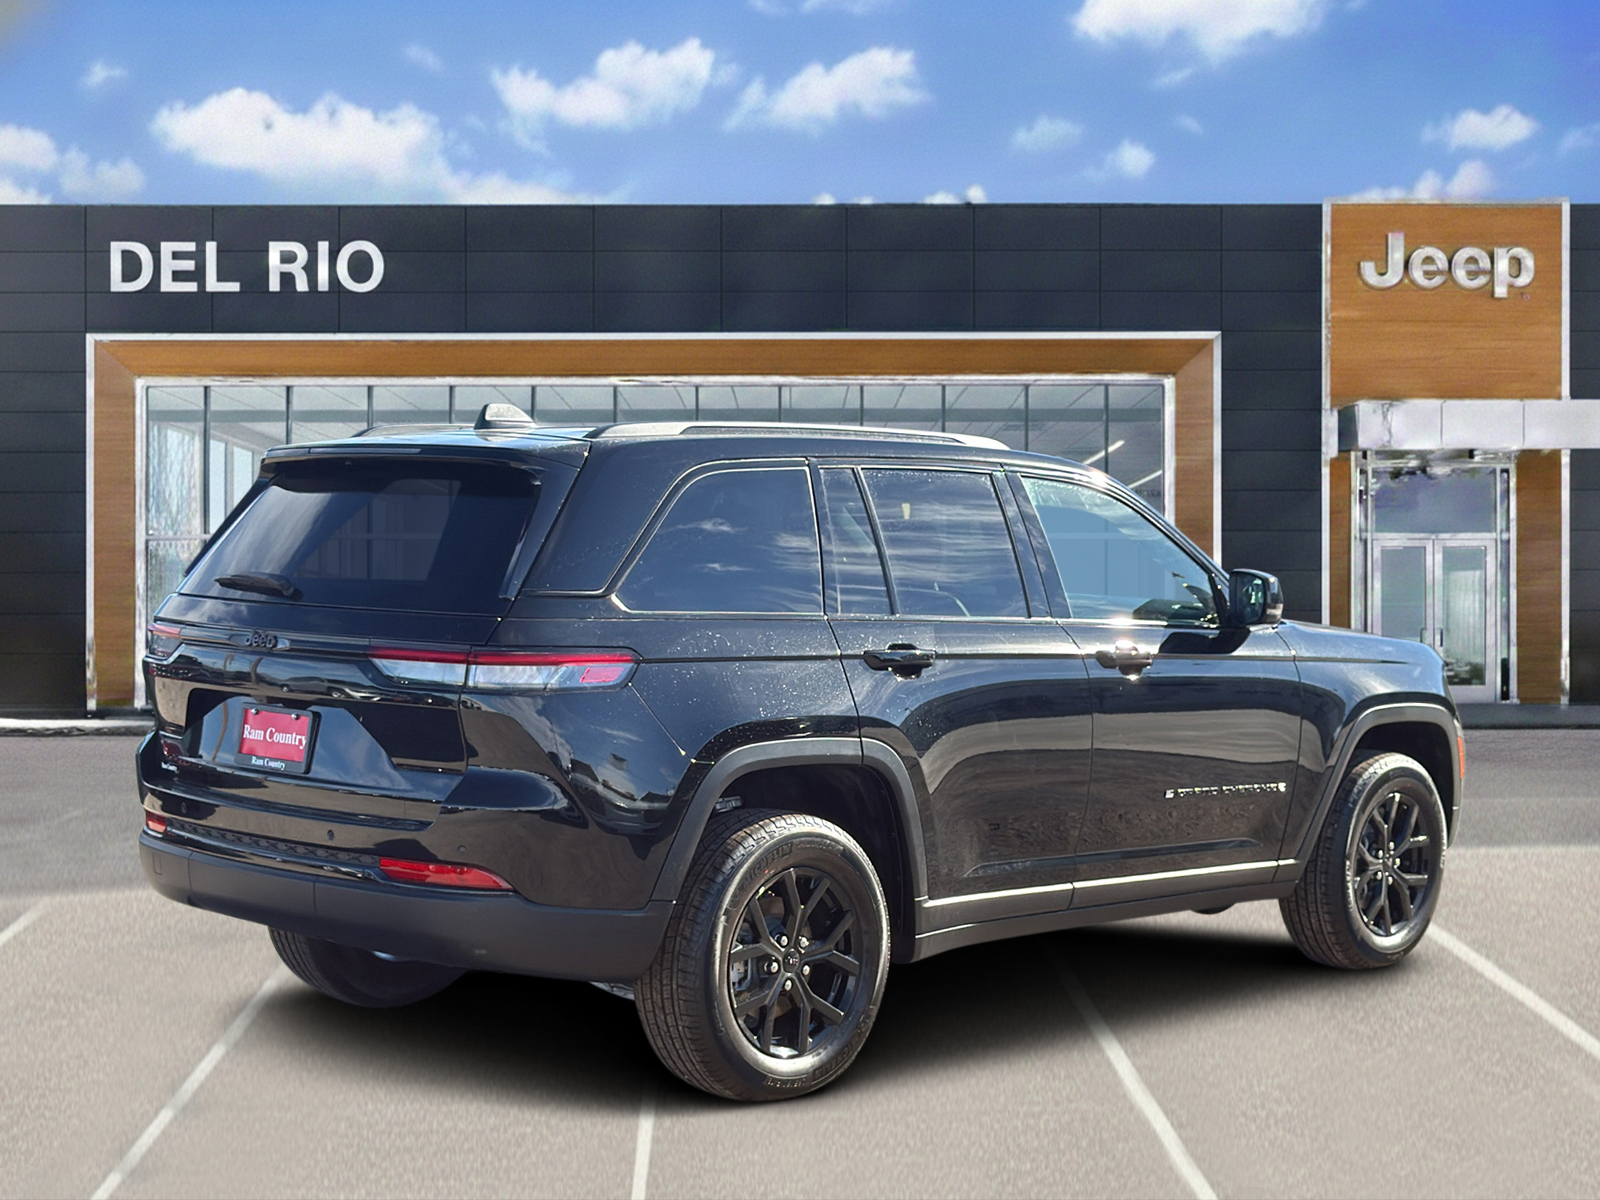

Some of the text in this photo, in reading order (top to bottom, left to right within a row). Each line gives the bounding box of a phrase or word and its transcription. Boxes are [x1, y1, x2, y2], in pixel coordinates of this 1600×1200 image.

[110, 240, 385, 293] DEL RIO
[1360, 231, 1535, 298] Jeep
[243, 724, 307, 750] Ram Country
[251, 756, 285, 771] Ram Country
